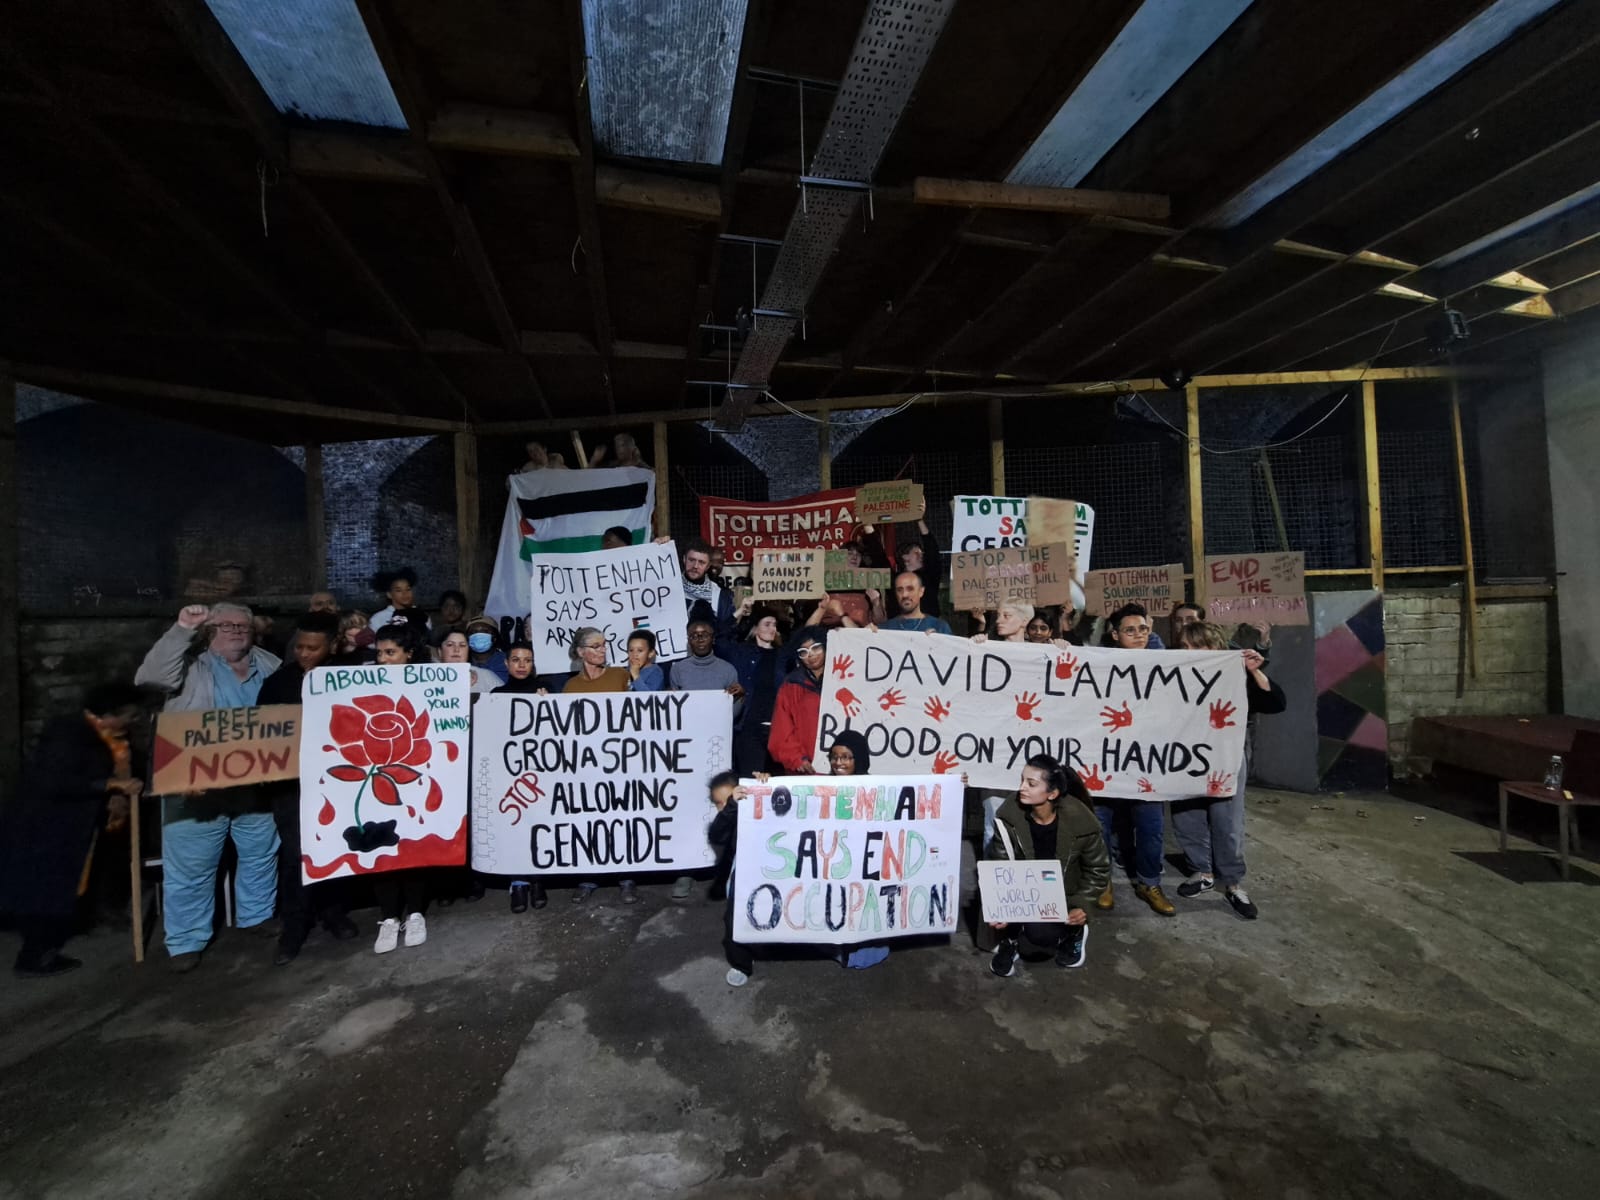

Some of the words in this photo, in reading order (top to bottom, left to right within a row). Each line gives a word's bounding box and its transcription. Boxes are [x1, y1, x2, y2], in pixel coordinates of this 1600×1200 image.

[863, 499, 911, 512] PALESTINE
[961, 498, 1087, 521] TOTTM
[715, 507, 860, 533] TOTTENHA
[718, 535, 763, 547] STOP
[771, 534, 800, 546] THE
[807, 527, 844, 542] WAR
[957, 552, 1006, 569] STOP
[1019, 547, 1050, 562] THE
[536, 554, 677, 595] TOTTENHAM
[762, 567, 811, 577] AGAINST
[962, 575, 1031, 591] PALESTINE
[1035, 573, 1059, 585] WILL
[1100, 569, 1169, 586] TOTTENHAM
[1210, 558, 1260, 583] END
[758, 580, 813, 593] GENOCIDE
[985, 591, 1000, 603] BE
[1008, 588, 1037, 600] FREE
[1236, 578, 1272, 594] THE
[546, 598, 598, 622] SAYS
[609, 586, 670, 613] STOP
[546, 624, 617, 648] ARMG
[608, 628, 688, 664] ISEL
[309, 668, 392, 694] LABOUR
[404, 665, 458, 685] BLOOD
[865, 646, 1012, 692] DAVID
[1044, 659, 1222, 706] LAMMY
[424, 687, 444, 697] ON
[427, 697, 460, 711] YOUR
[202, 708, 259, 729] FREE
[433, 715, 470, 733] HANDS
[510, 697, 599, 737] DAVID
[606, 693, 689, 733] LAMMY
[185, 720, 295, 747] PALESTINE
[189, 746, 291, 784] NOW
[503, 738, 577, 776] GROW
[581, 747, 598, 769] A
[601, 738, 693, 774] SPINE
[954, 733, 994, 763] ON
[1006, 735, 1085, 770] YOUR
[1101, 736, 1213, 777] HANDS
[499, 772, 546, 825] STOP
[551, 778, 677, 815] ALLOWING
[745, 784, 941, 821] TOTTENHAM
[531, 817, 674, 869] GENOCIDE
[760, 828, 852, 880] SAYS
[862, 829, 927, 881] END
[994, 867, 1016, 885] FOR
[1025, 868, 1037, 883] A
[746, 876, 954, 932] OCCUPATION!
[997, 888, 1040, 904] WORLD
[987, 903, 1038, 919] WITHOUT
[1039, 902, 1060, 917] WAR
